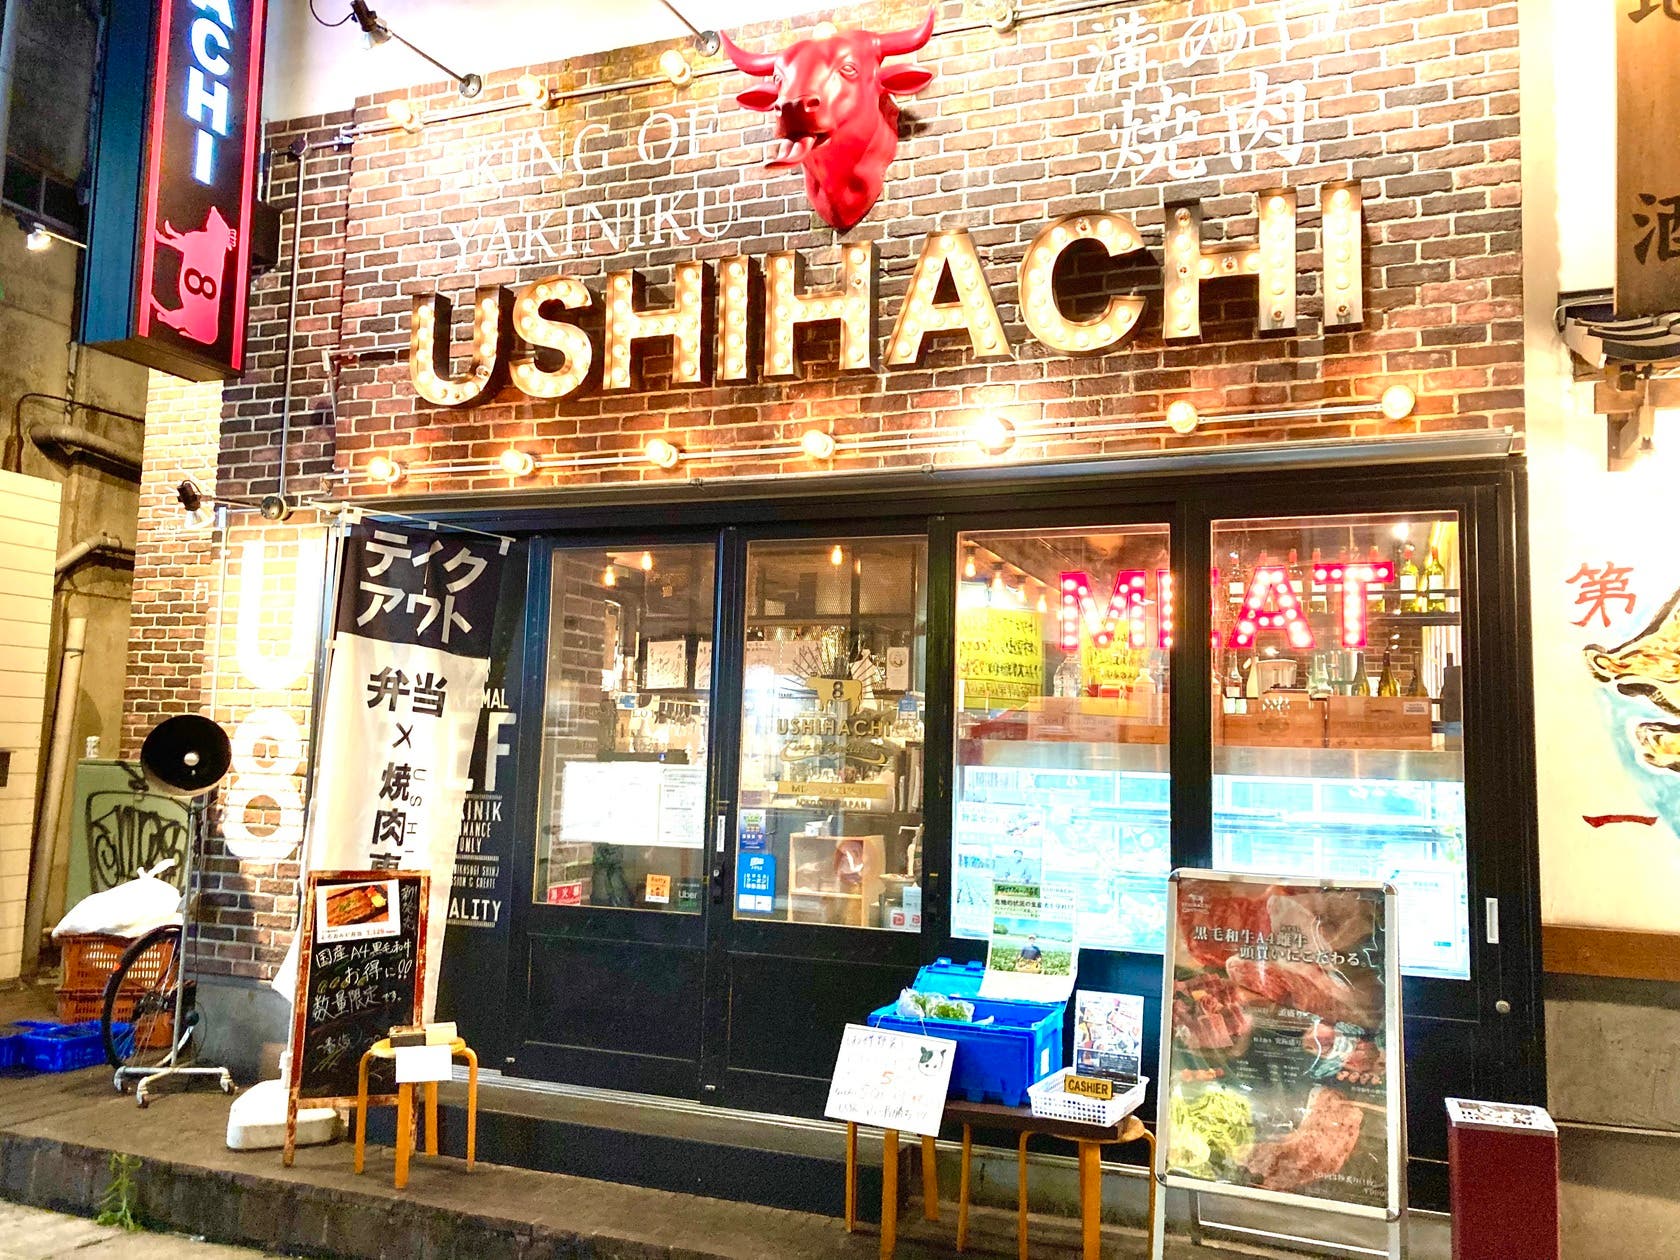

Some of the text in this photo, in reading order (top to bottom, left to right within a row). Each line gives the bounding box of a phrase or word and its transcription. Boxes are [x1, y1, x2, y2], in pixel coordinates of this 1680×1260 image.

[472, 104, 720, 185] KING OF
[1108, 70, 1306, 185] 焼肉
[447, 185, 737, 269] YAKINIKU
[184, 268, 217, 300] 8
[410, 181, 1366, 408] USHIHACHI
[356, 580, 473, 644] アウト
[367, 666, 448, 718] 弁当
[832, 680, 843, 699] 8
[776, 717, 893, 737] USHIHACHI
[448, 898, 502, 922] ALITY
[678, 890, 698, 899] Uber
[1068, 1078, 1109, 1095] CASHIER
